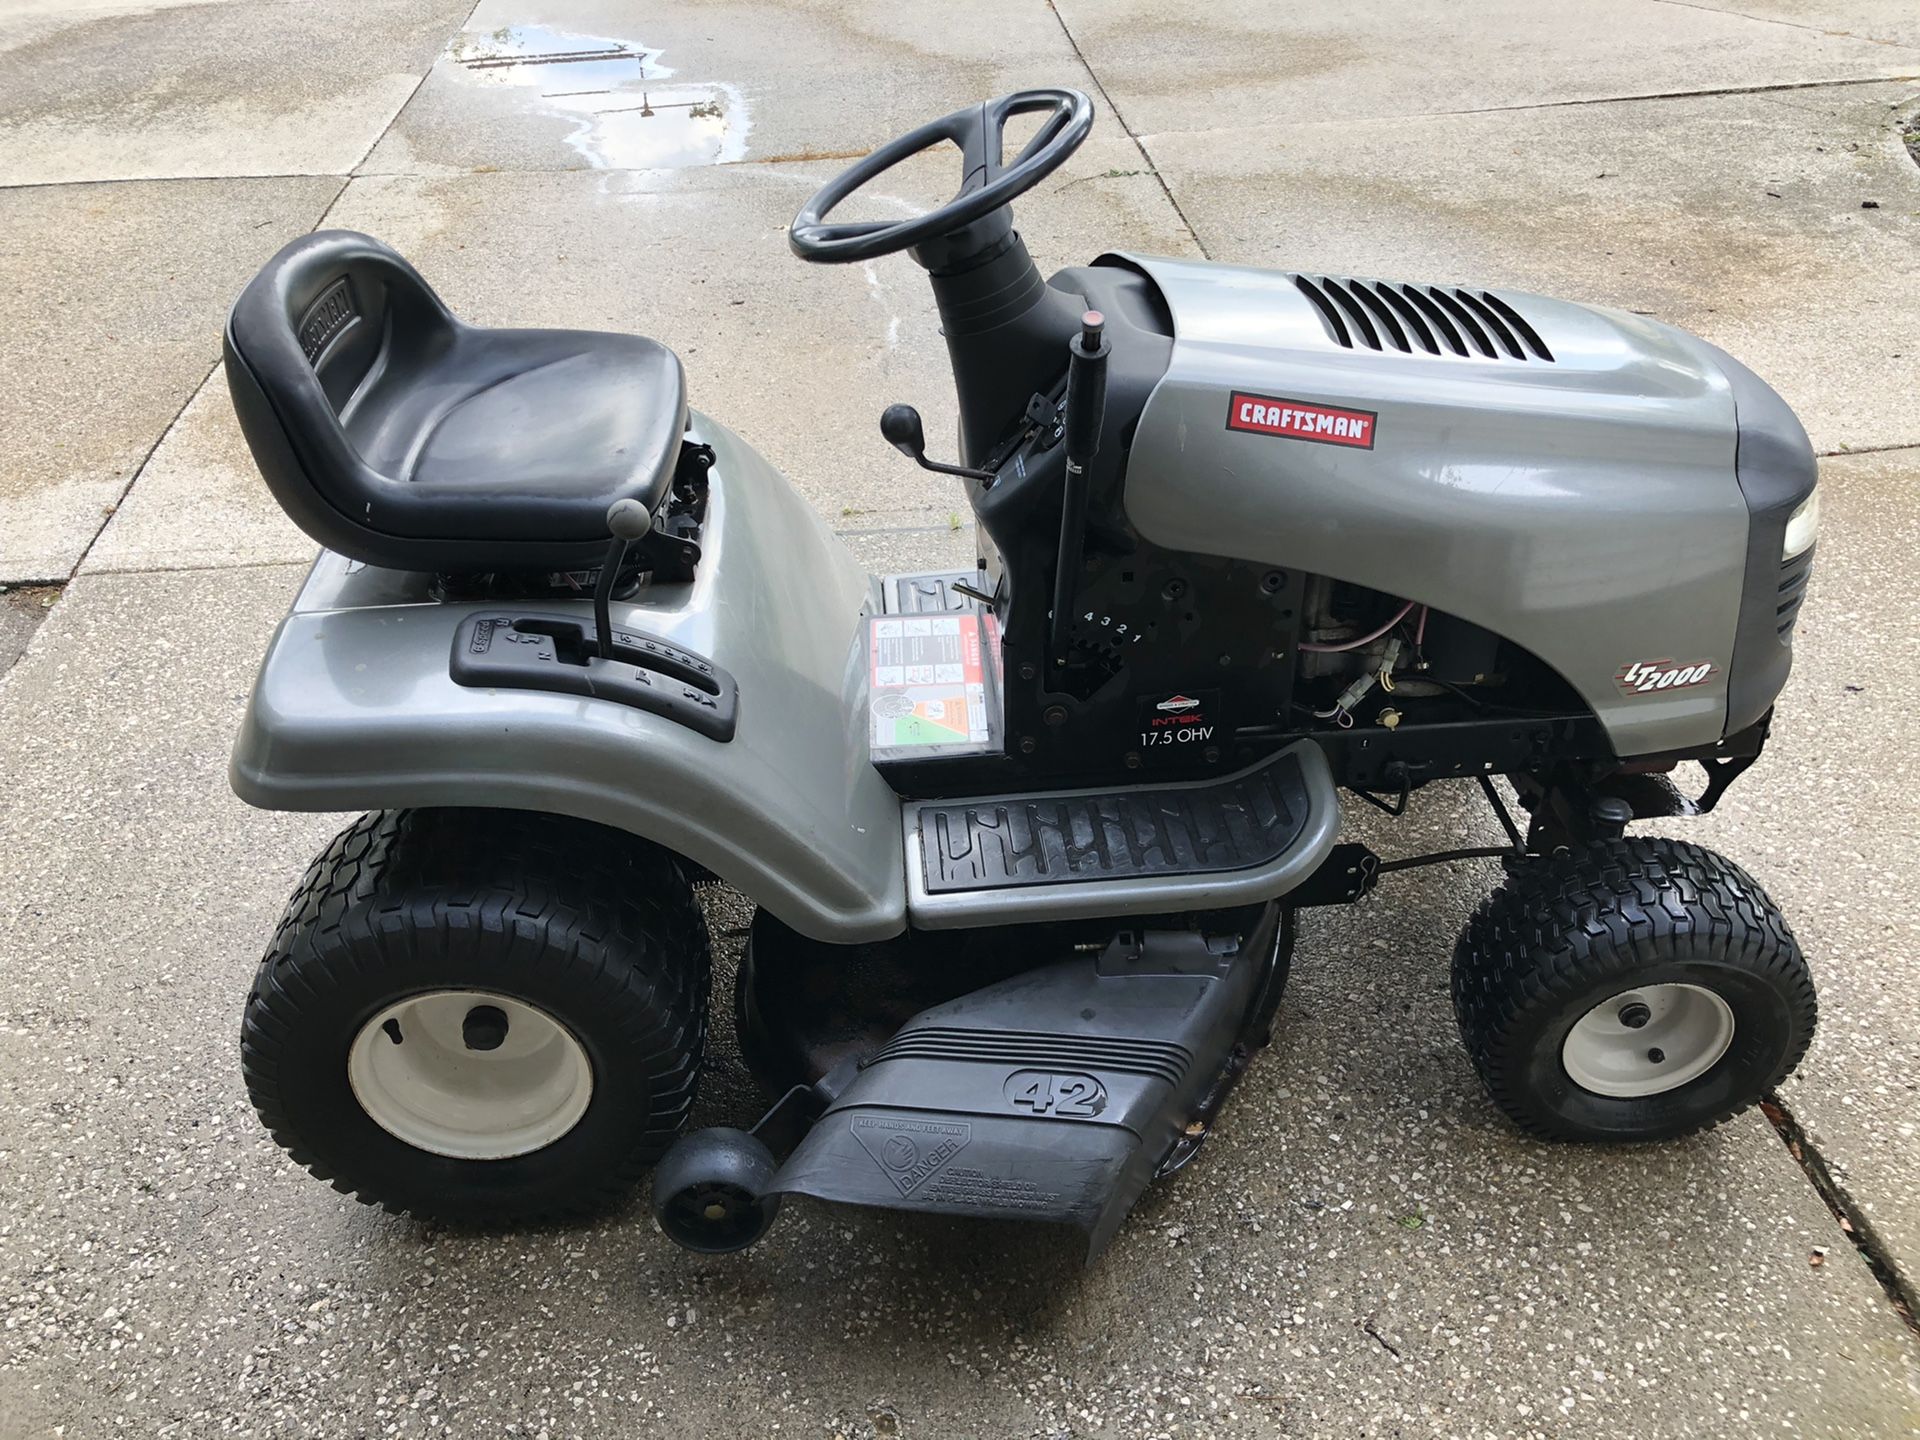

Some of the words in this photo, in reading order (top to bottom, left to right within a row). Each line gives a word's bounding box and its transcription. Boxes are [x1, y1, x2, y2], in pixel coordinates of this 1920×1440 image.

[1084, 611, 1095, 622] 4
[1100, 616, 1112, 627] 3
[1116, 623, 1128, 635] 2
[1132, 634, 1142, 644] 1
[1623, 662, 1712, 692] LT2000
[1151, 714, 1204, 727] INTEK
[1141, 730, 1173, 746] 17.5
[1177, 726, 1214, 743] OHV
[1013, 1072, 1098, 1115] 42
[879, 1120, 904, 1131] HANDS
[941, 1124, 964, 1136] AWAY
[899, 1138, 960, 1191] DANGER
